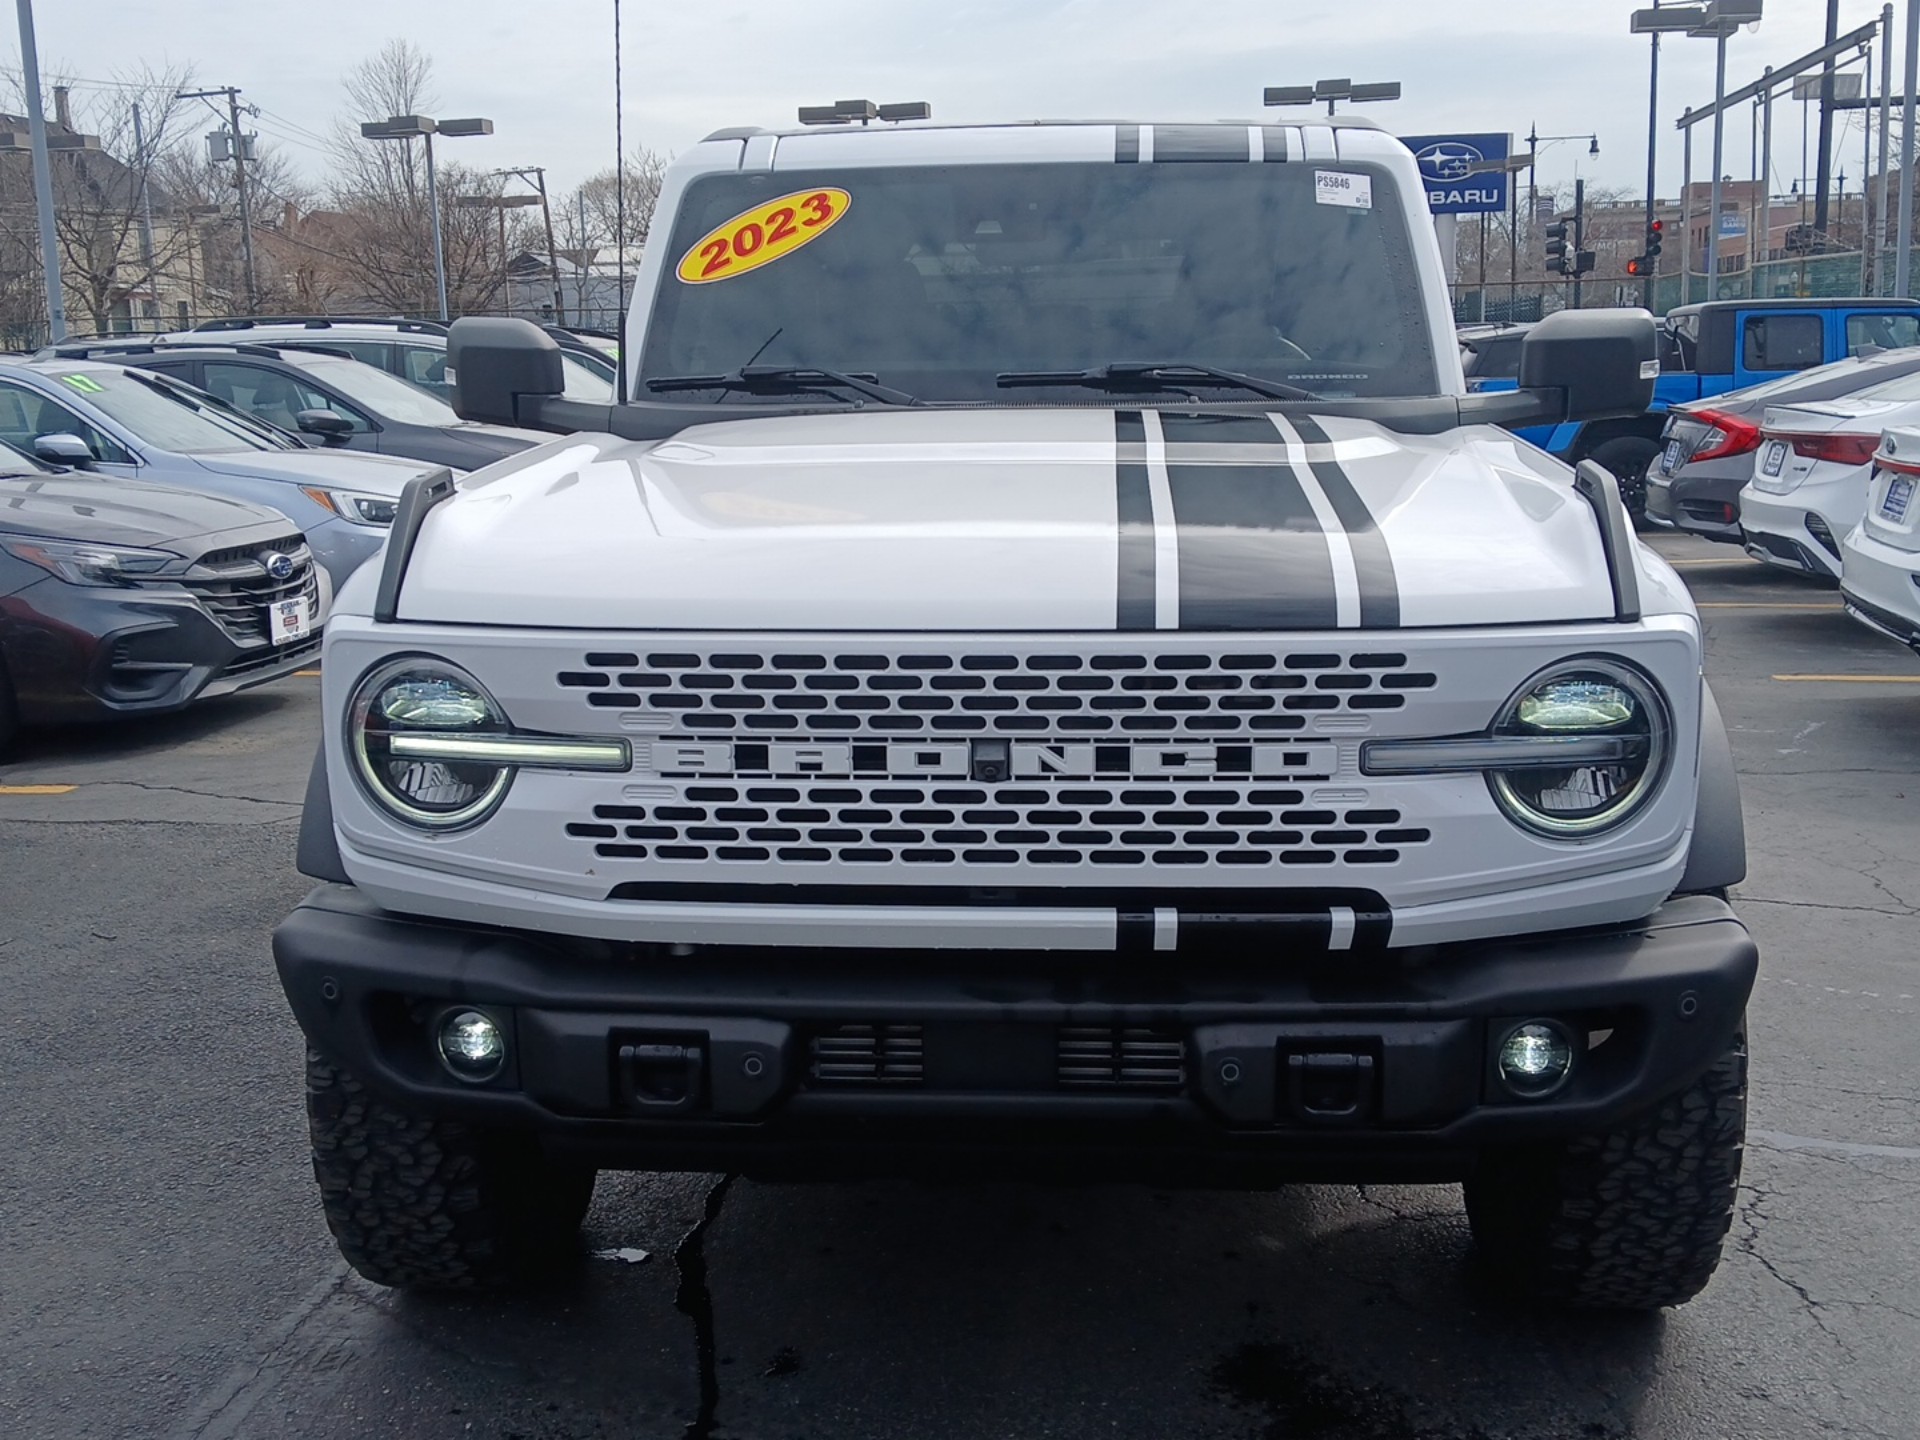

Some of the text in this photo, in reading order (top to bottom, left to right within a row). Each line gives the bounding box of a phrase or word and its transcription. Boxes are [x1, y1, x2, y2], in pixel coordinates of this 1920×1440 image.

[1317, 175, 1350, 189] PS5846
[1425, 189, 1498, 204] BARU
[699, 193, 835, 278] 2023
[651, 742, 1339, 776] BRONCO
